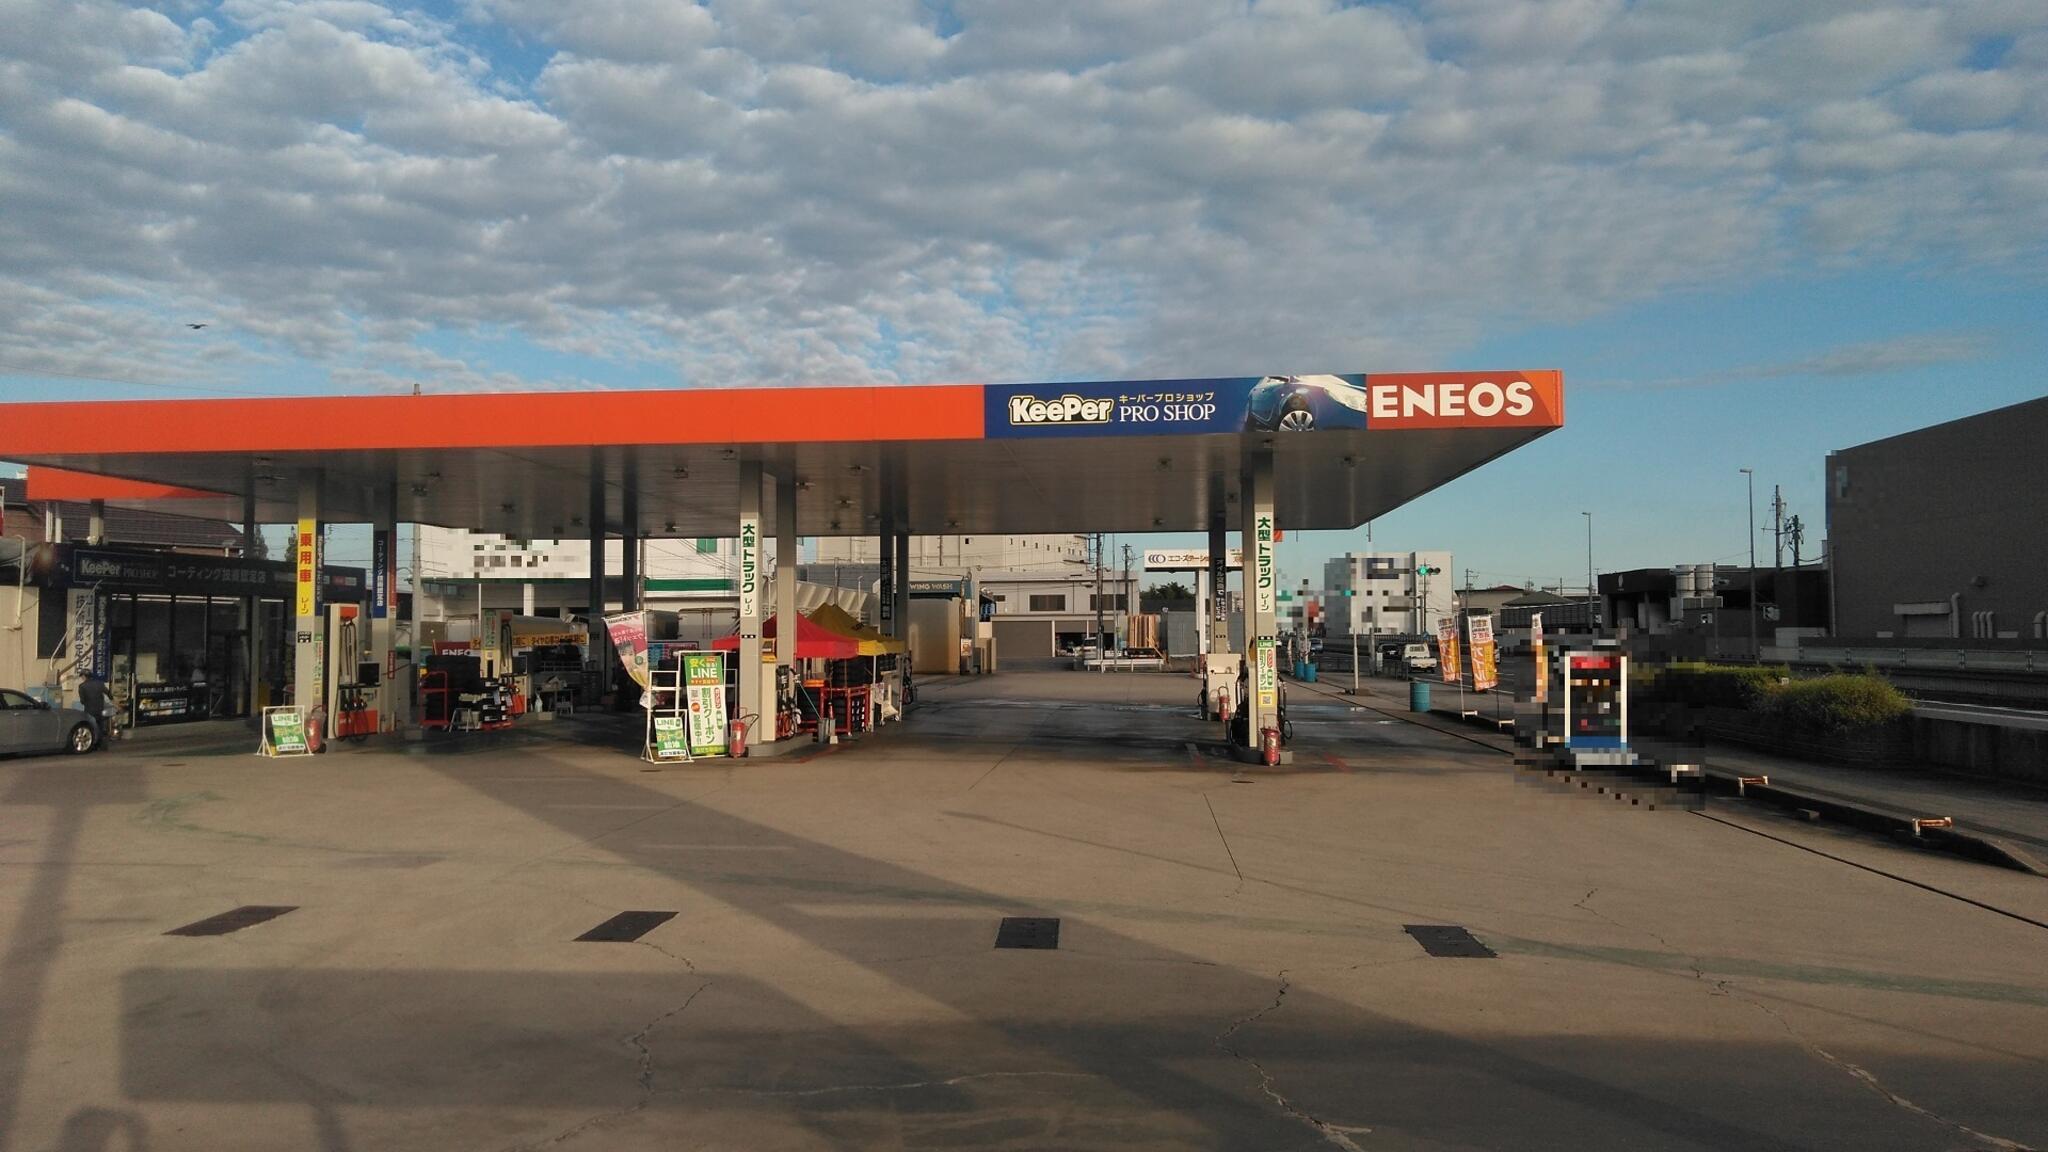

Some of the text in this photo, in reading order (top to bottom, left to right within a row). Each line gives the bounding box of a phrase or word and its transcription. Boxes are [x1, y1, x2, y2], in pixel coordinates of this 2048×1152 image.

[1010, 395, 1113, 425] KeePer
[1119, 391, 1214, 404] キーパープロショップ
[1119, 403, 1216, 422] PRO SHOP
[1372, 381, 1534, 417] ENEOS
[81, 559, 121, 576] KeePer
[300, 533, 312, 582] 乗用車
[742, 524, 755, 593] 大型トラック
[1258, 517, 1271, 588] 大型トラック
[691, 668, 718, 678] LINE
